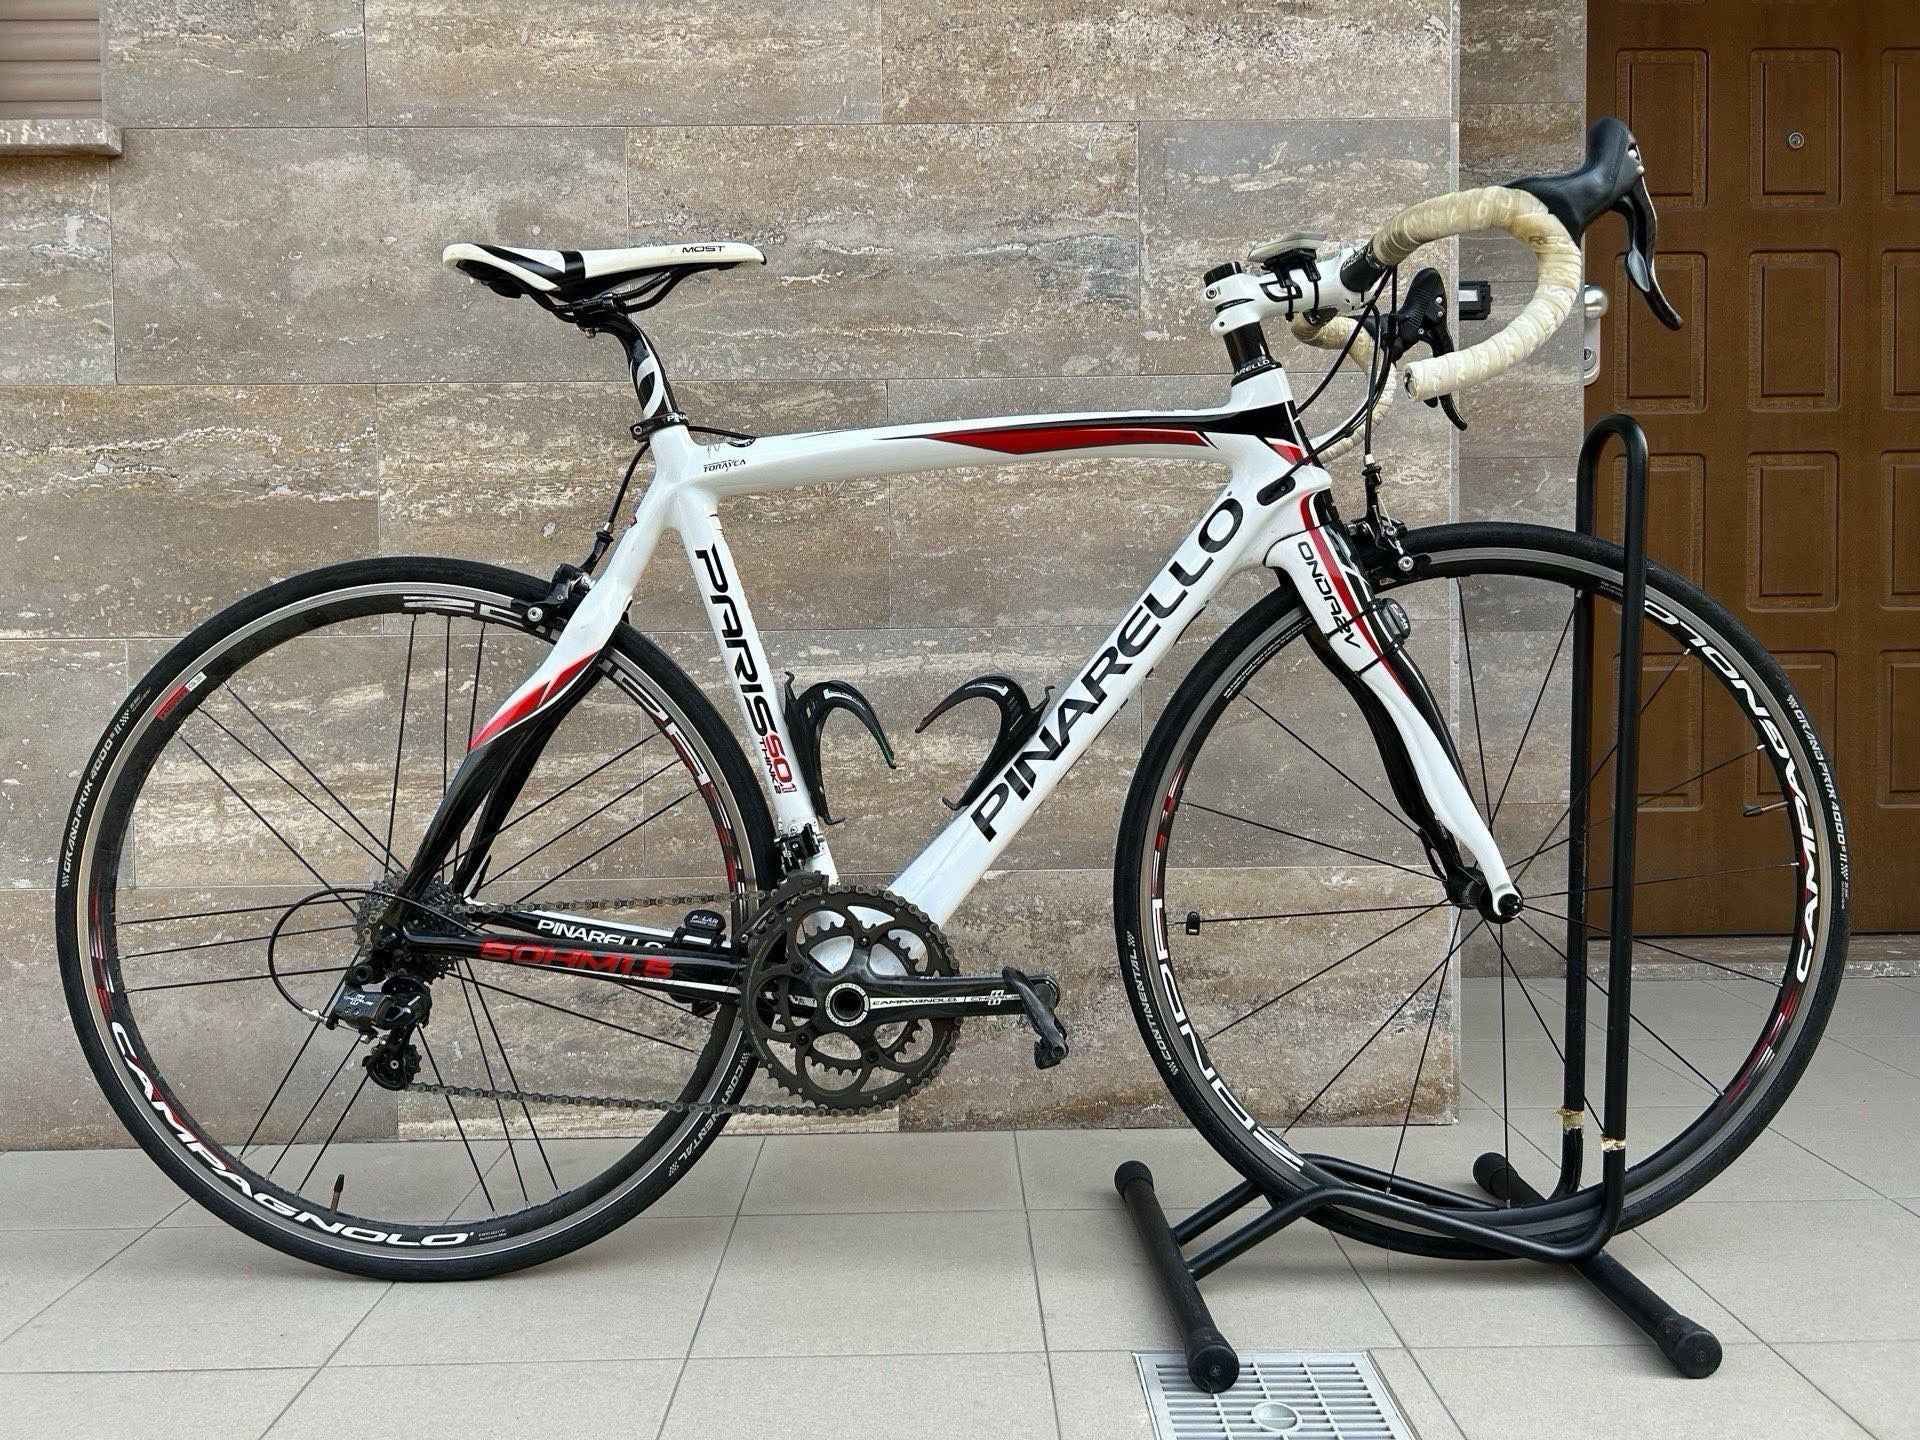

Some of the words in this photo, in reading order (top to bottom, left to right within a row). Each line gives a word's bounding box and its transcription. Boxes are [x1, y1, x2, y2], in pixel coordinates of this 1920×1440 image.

[682, 245, 726, 254] MOST
[703, 459, 747, 472] TORAYCA
[695, 543, 778, 736] PARIS
[970, 498, 1244, 843] PINARELLO
[1644, 600, 1819, 983] CAMPAGNOLO
[1793, 709, 1824, 762] GRAND
[1819, 761, 1838, 800] PRIX
[64, 817, 81, 873] GRAND
[76, 779, 94, 817] PRIX
[872, 997, 957, 1006] CAMPAGNOLO
[1126, 947, 1171, 1066] CONTINENTAL
[1152, 899, 1304, 1172] ZONDA
[111, 1021, 471, 1247] CAMPAGNOLO
[677, 1066, 744, 1162] CONTNENTAL
